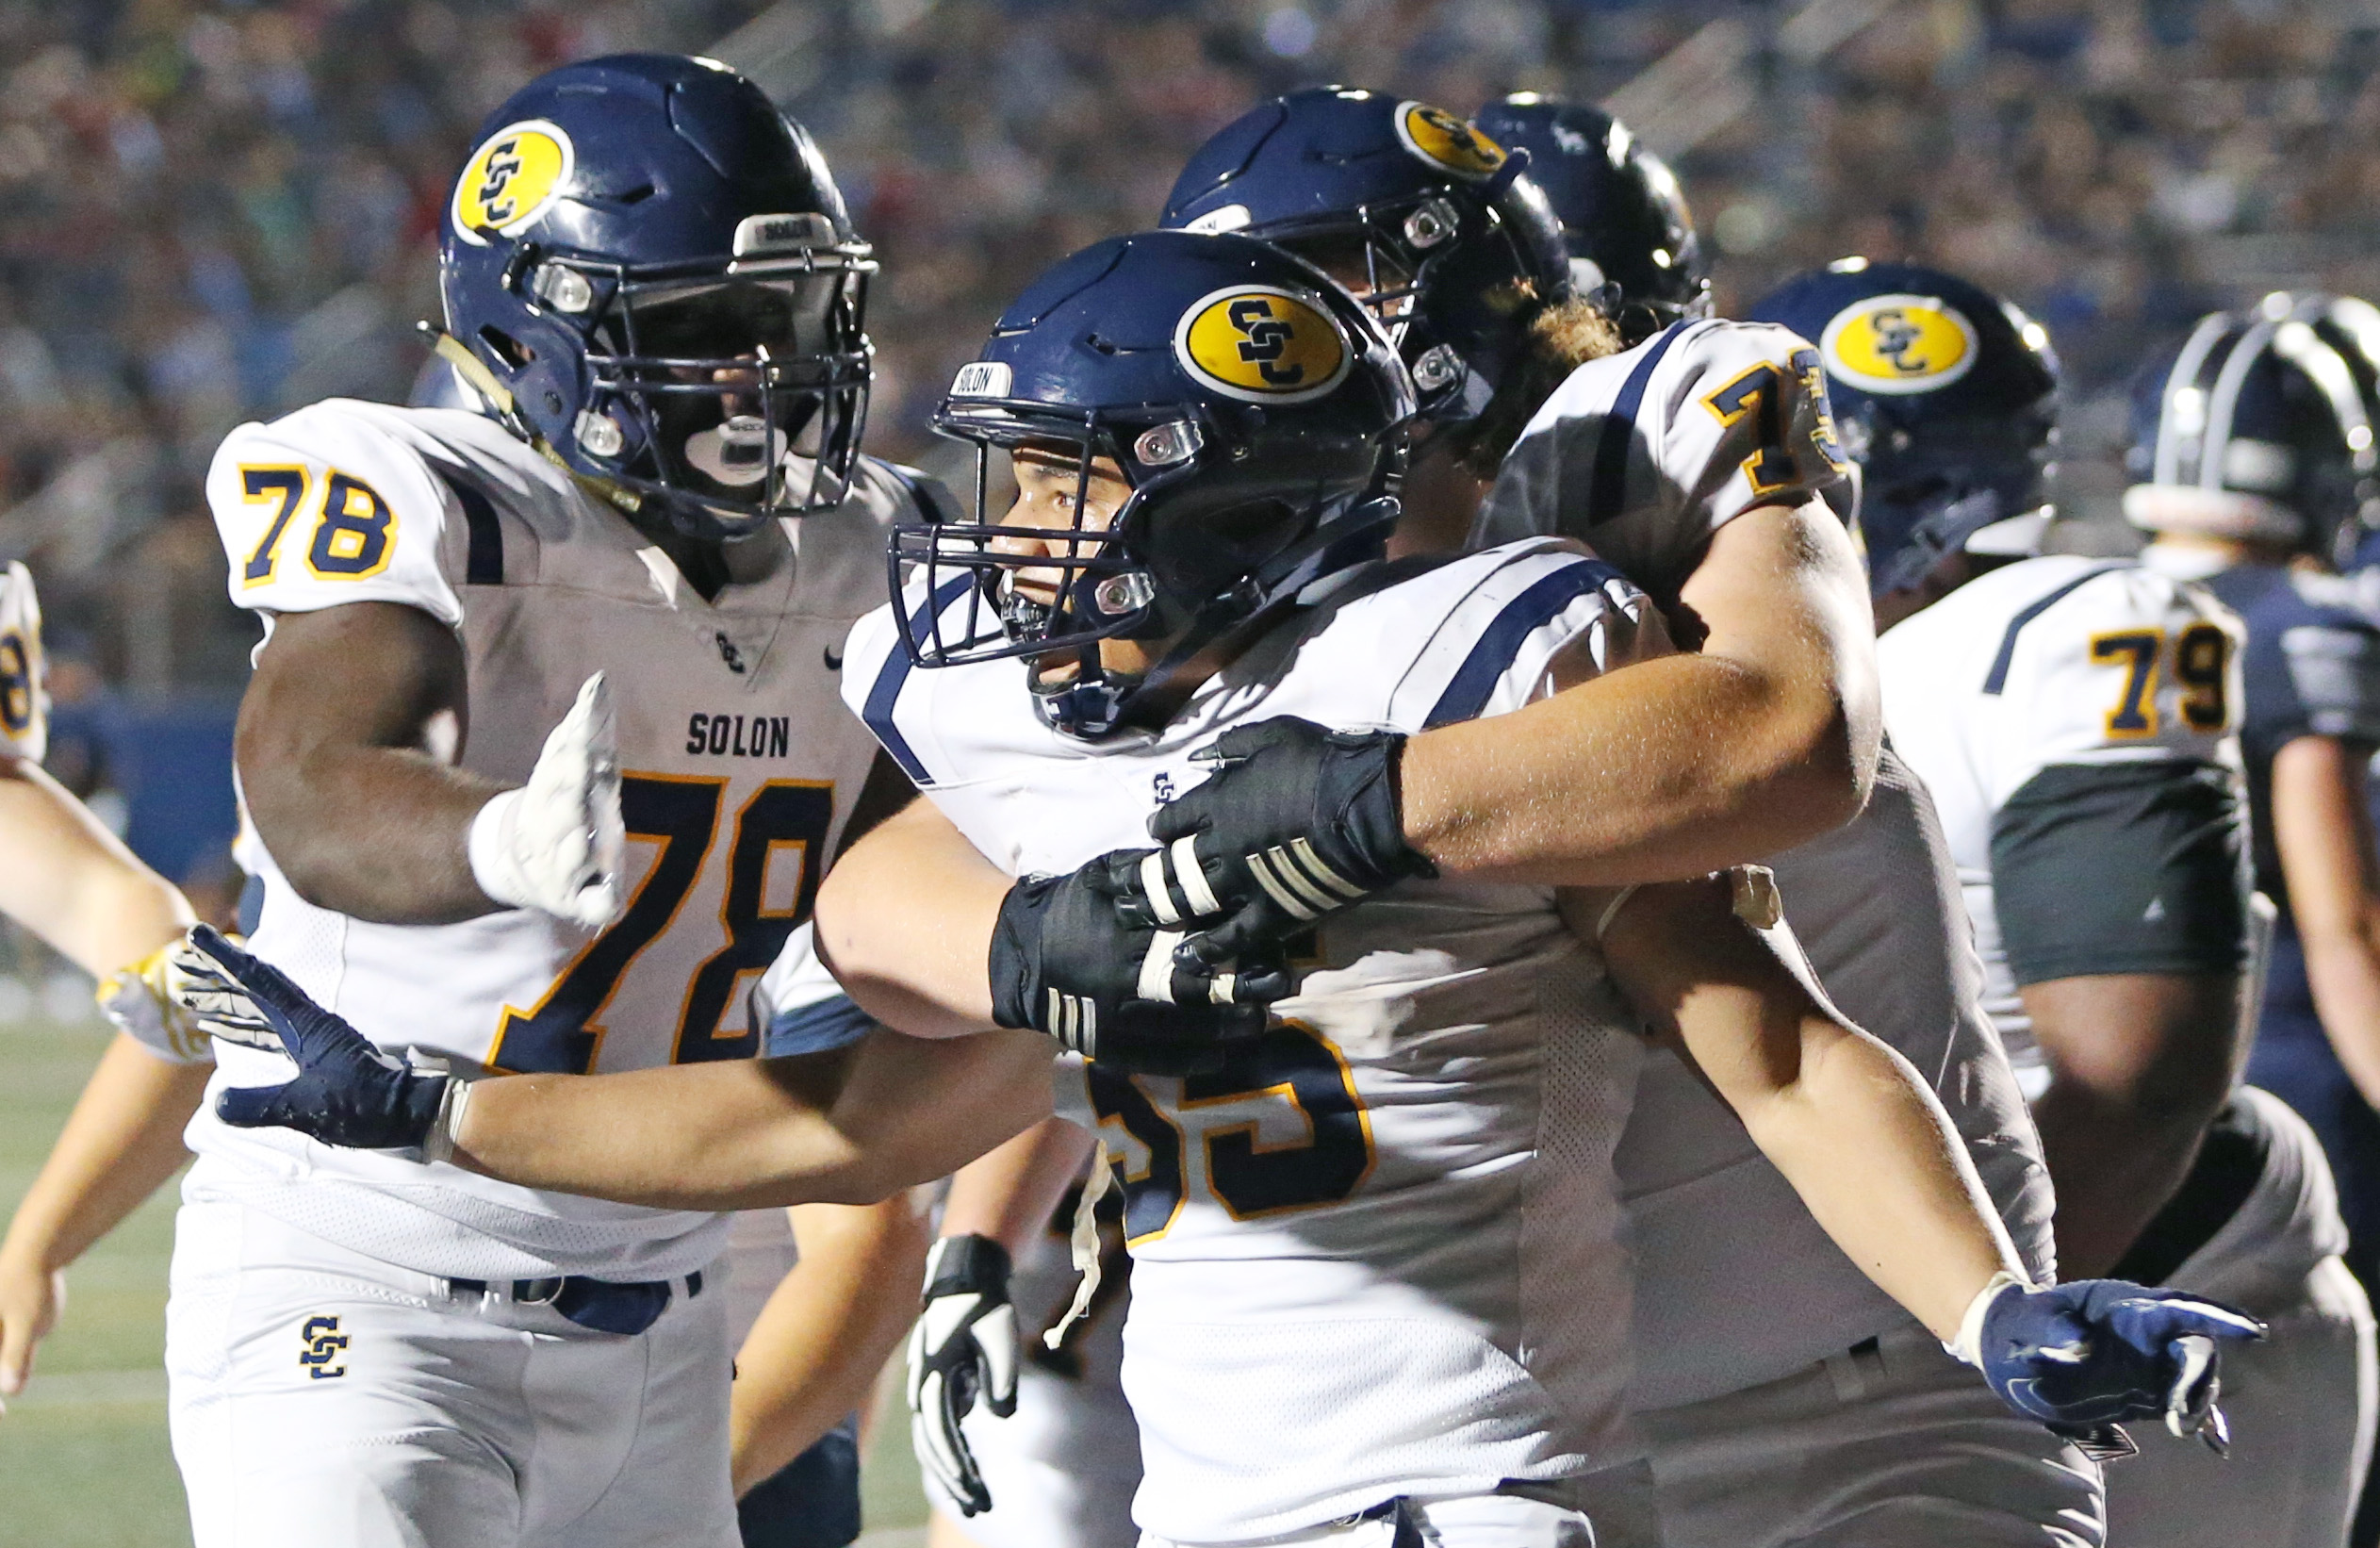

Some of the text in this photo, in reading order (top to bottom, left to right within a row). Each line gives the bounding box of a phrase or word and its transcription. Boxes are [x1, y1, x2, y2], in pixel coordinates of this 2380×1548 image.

[237, 461, 401, 591] 78
[685, 712, 790, 758] SOLON
[2087, 622, 2226, 740] 79
[484, 769, 836, 1077] 78
[299, 1314, 352, 1380] SC
